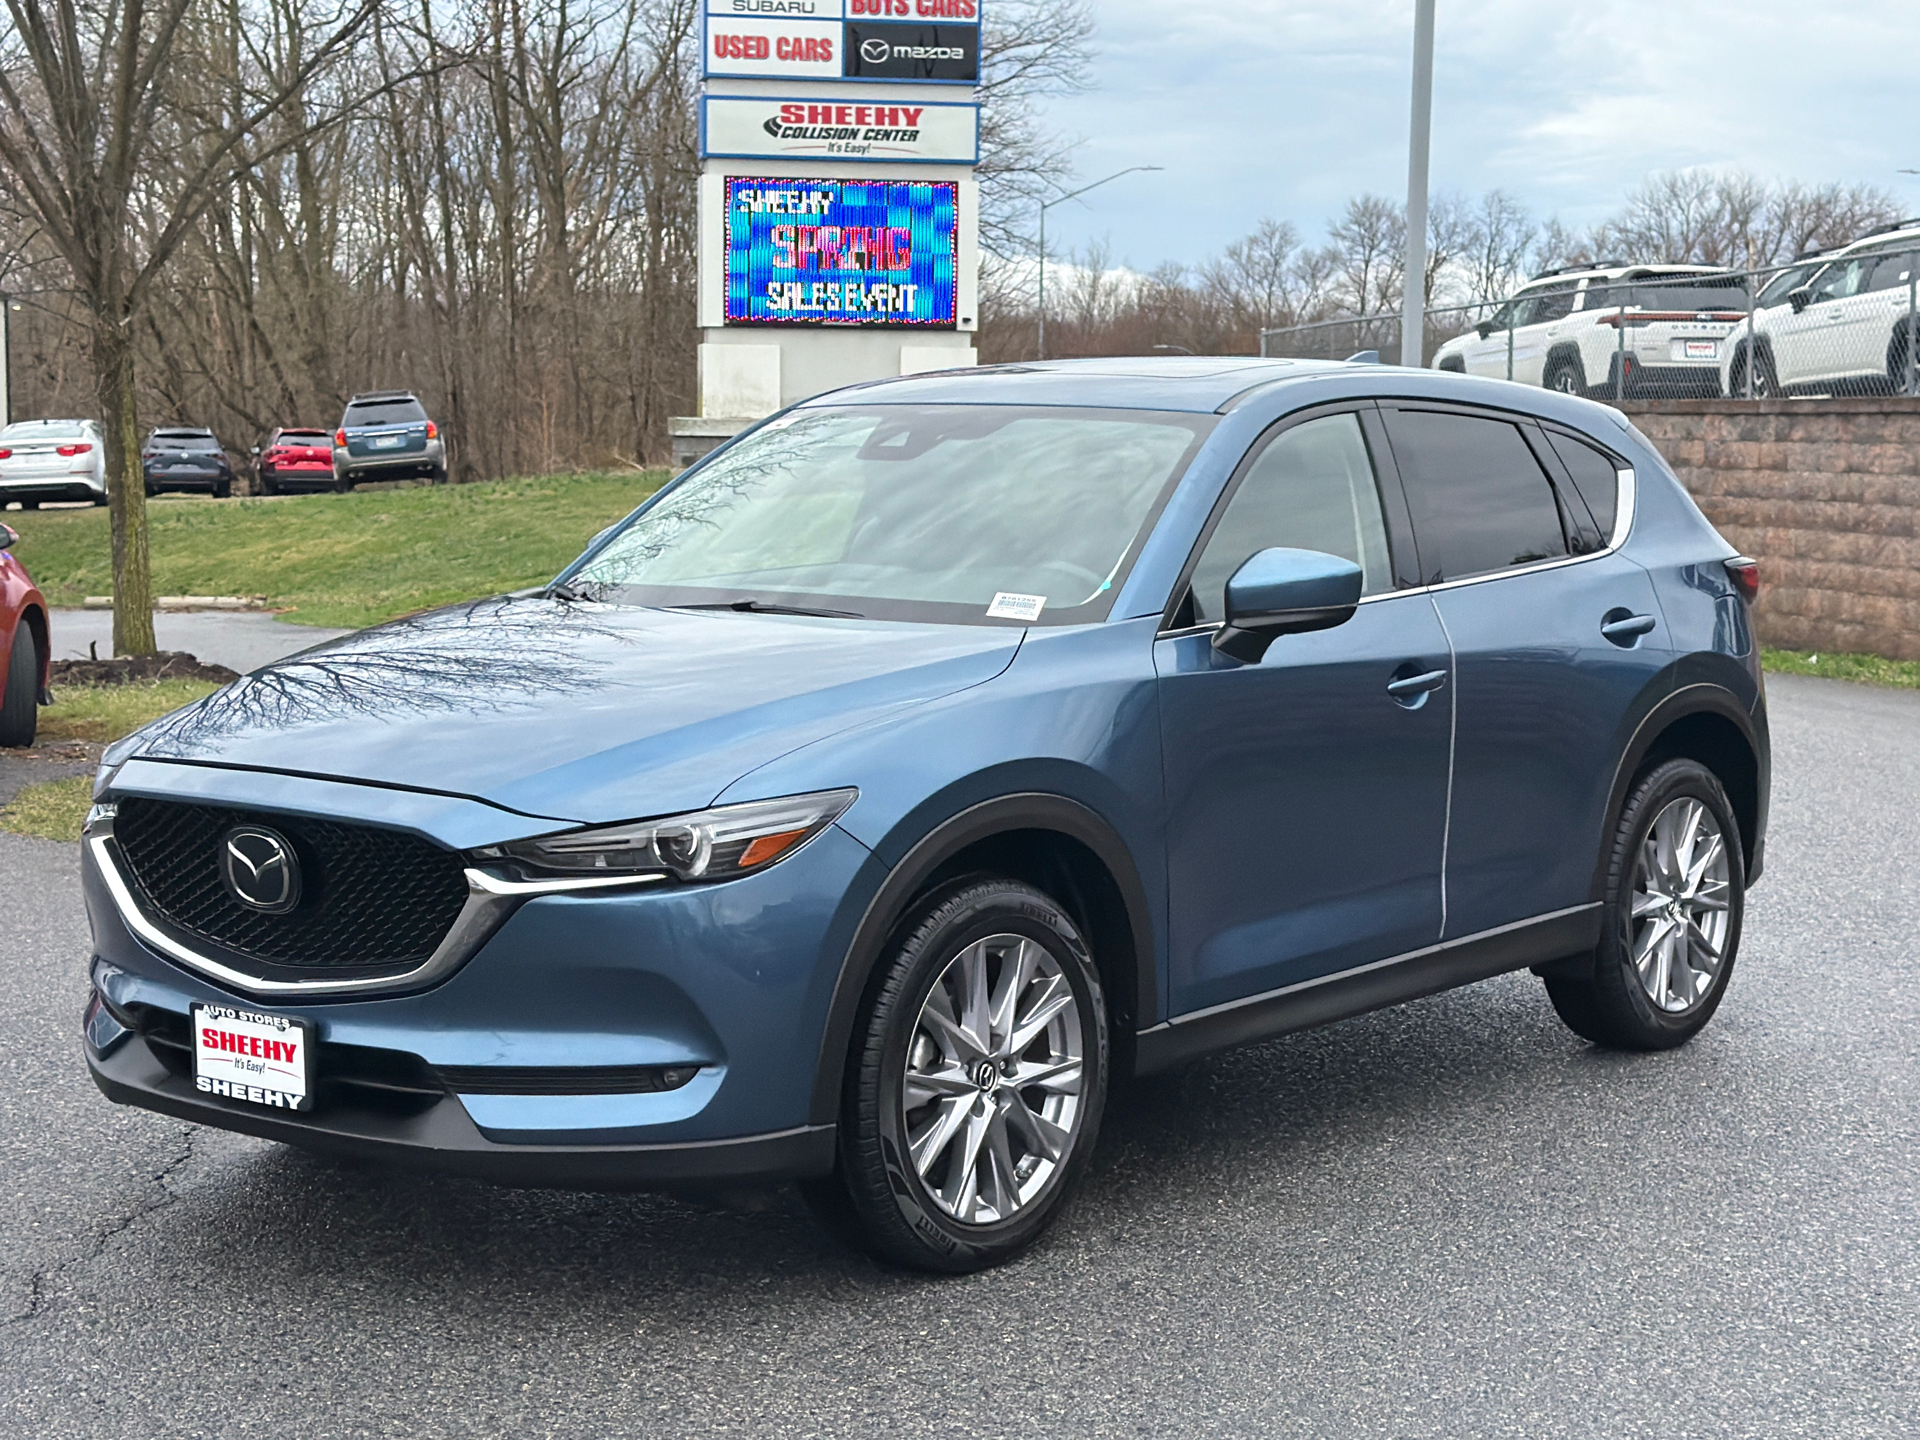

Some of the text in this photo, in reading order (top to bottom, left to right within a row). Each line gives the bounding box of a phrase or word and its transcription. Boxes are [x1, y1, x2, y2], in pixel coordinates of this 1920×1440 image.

[732, 0, 815, 13] SUBARU
[916, 0, 976, 18] CARS
[714, 34, 833, 62] USED CARS
[893, 45, 964, 60] mazda
[780, 104, 924, 127] SHEEHY
[780, 126, 920, 142] COLLISION CENTER
[827, 142, 872, 155] It's Easy!
[766, 282, 840, 310] SALES
[202, 1004, 291, 1028] AUTO STORES
[202, 1028, 297, 1064] SHEEHY
[234, 1057, 266, 1075] It's Easy!
[196, 1076, 303, 1110] SHEEHY
